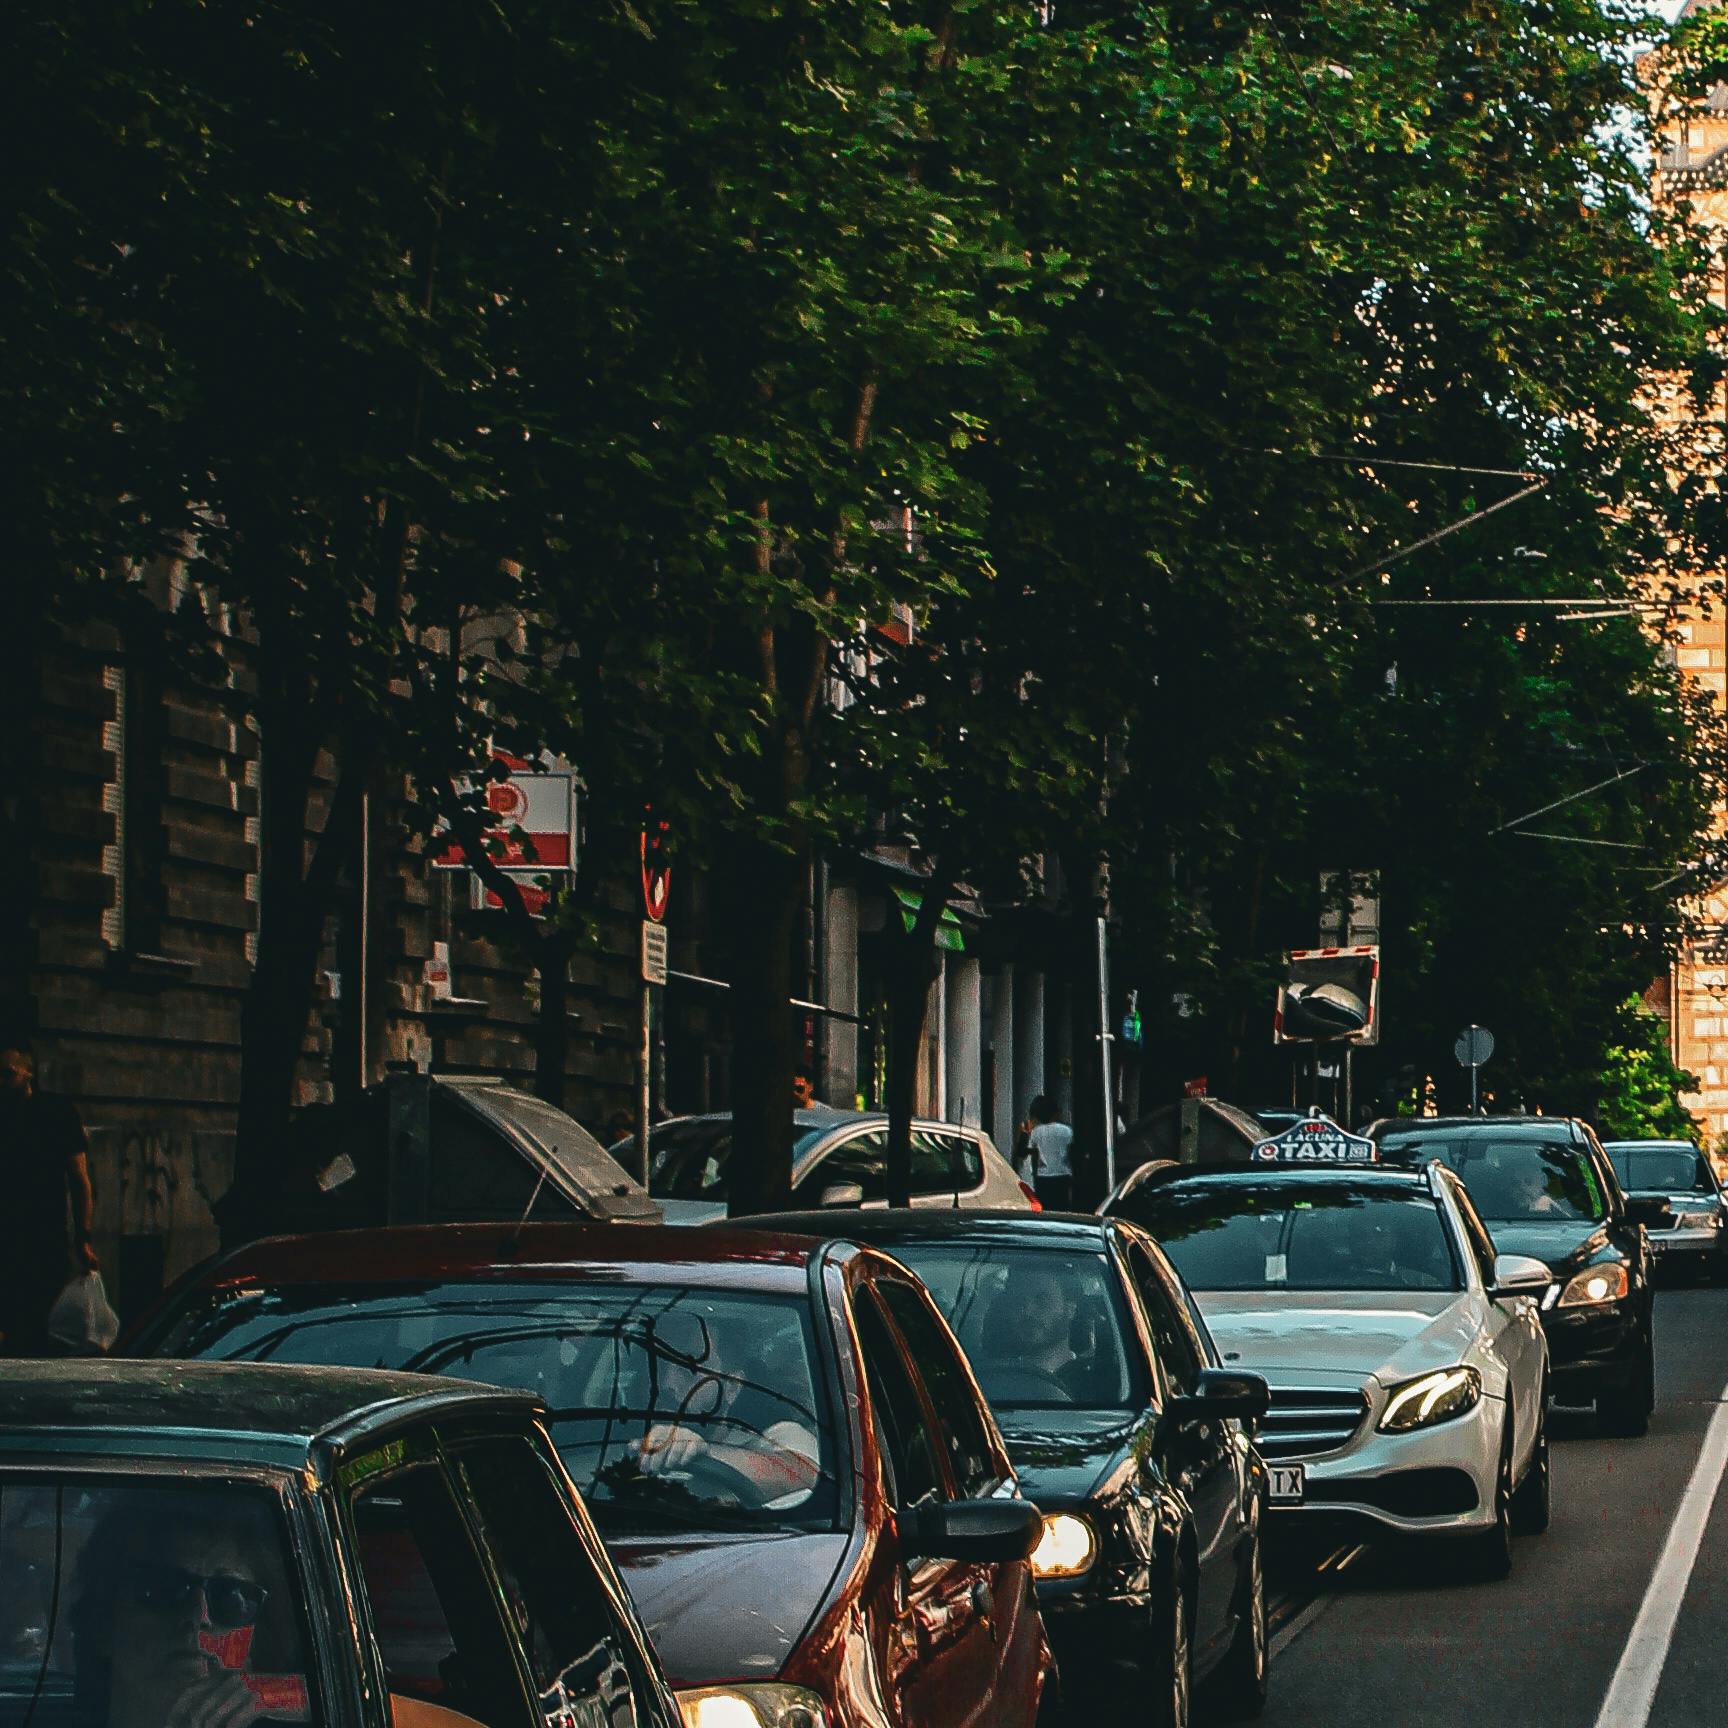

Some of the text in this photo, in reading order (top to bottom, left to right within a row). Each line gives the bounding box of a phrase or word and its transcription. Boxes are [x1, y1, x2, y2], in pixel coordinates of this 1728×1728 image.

[1286, 1130, 1345, 1143] LAGUNA
[1280, 1142, 1347, 1159] TAXI
[1273, 1470, 1301, 1494] TX
